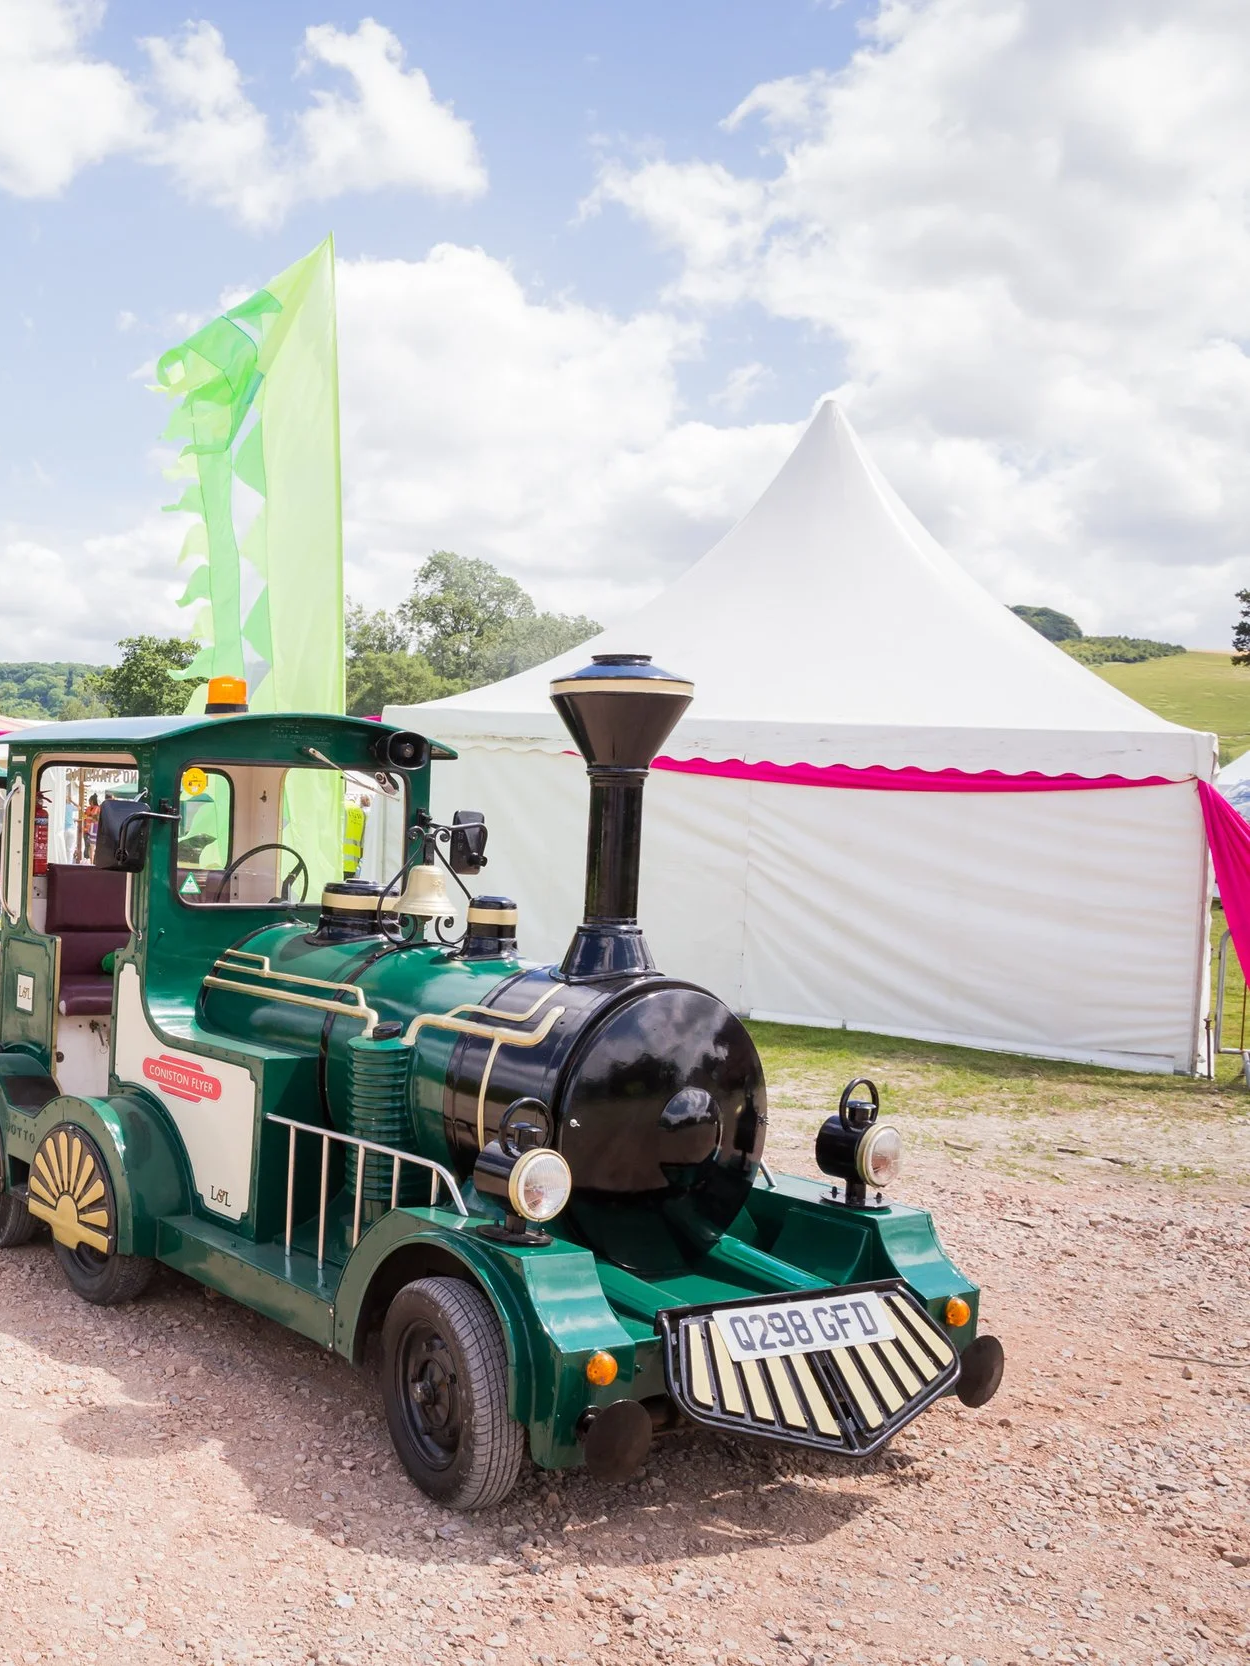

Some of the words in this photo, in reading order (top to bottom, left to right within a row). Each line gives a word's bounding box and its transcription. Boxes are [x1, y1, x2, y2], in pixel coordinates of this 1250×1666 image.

[149, 1064, 190, 1086] CONISTON
[191, 1077, 214, 1094] FLYER
[210, 1184, 232, 1208] L&L
[729, 1309, 815, 1352] Q298
[812, 1301, 879, 1341] GFD
